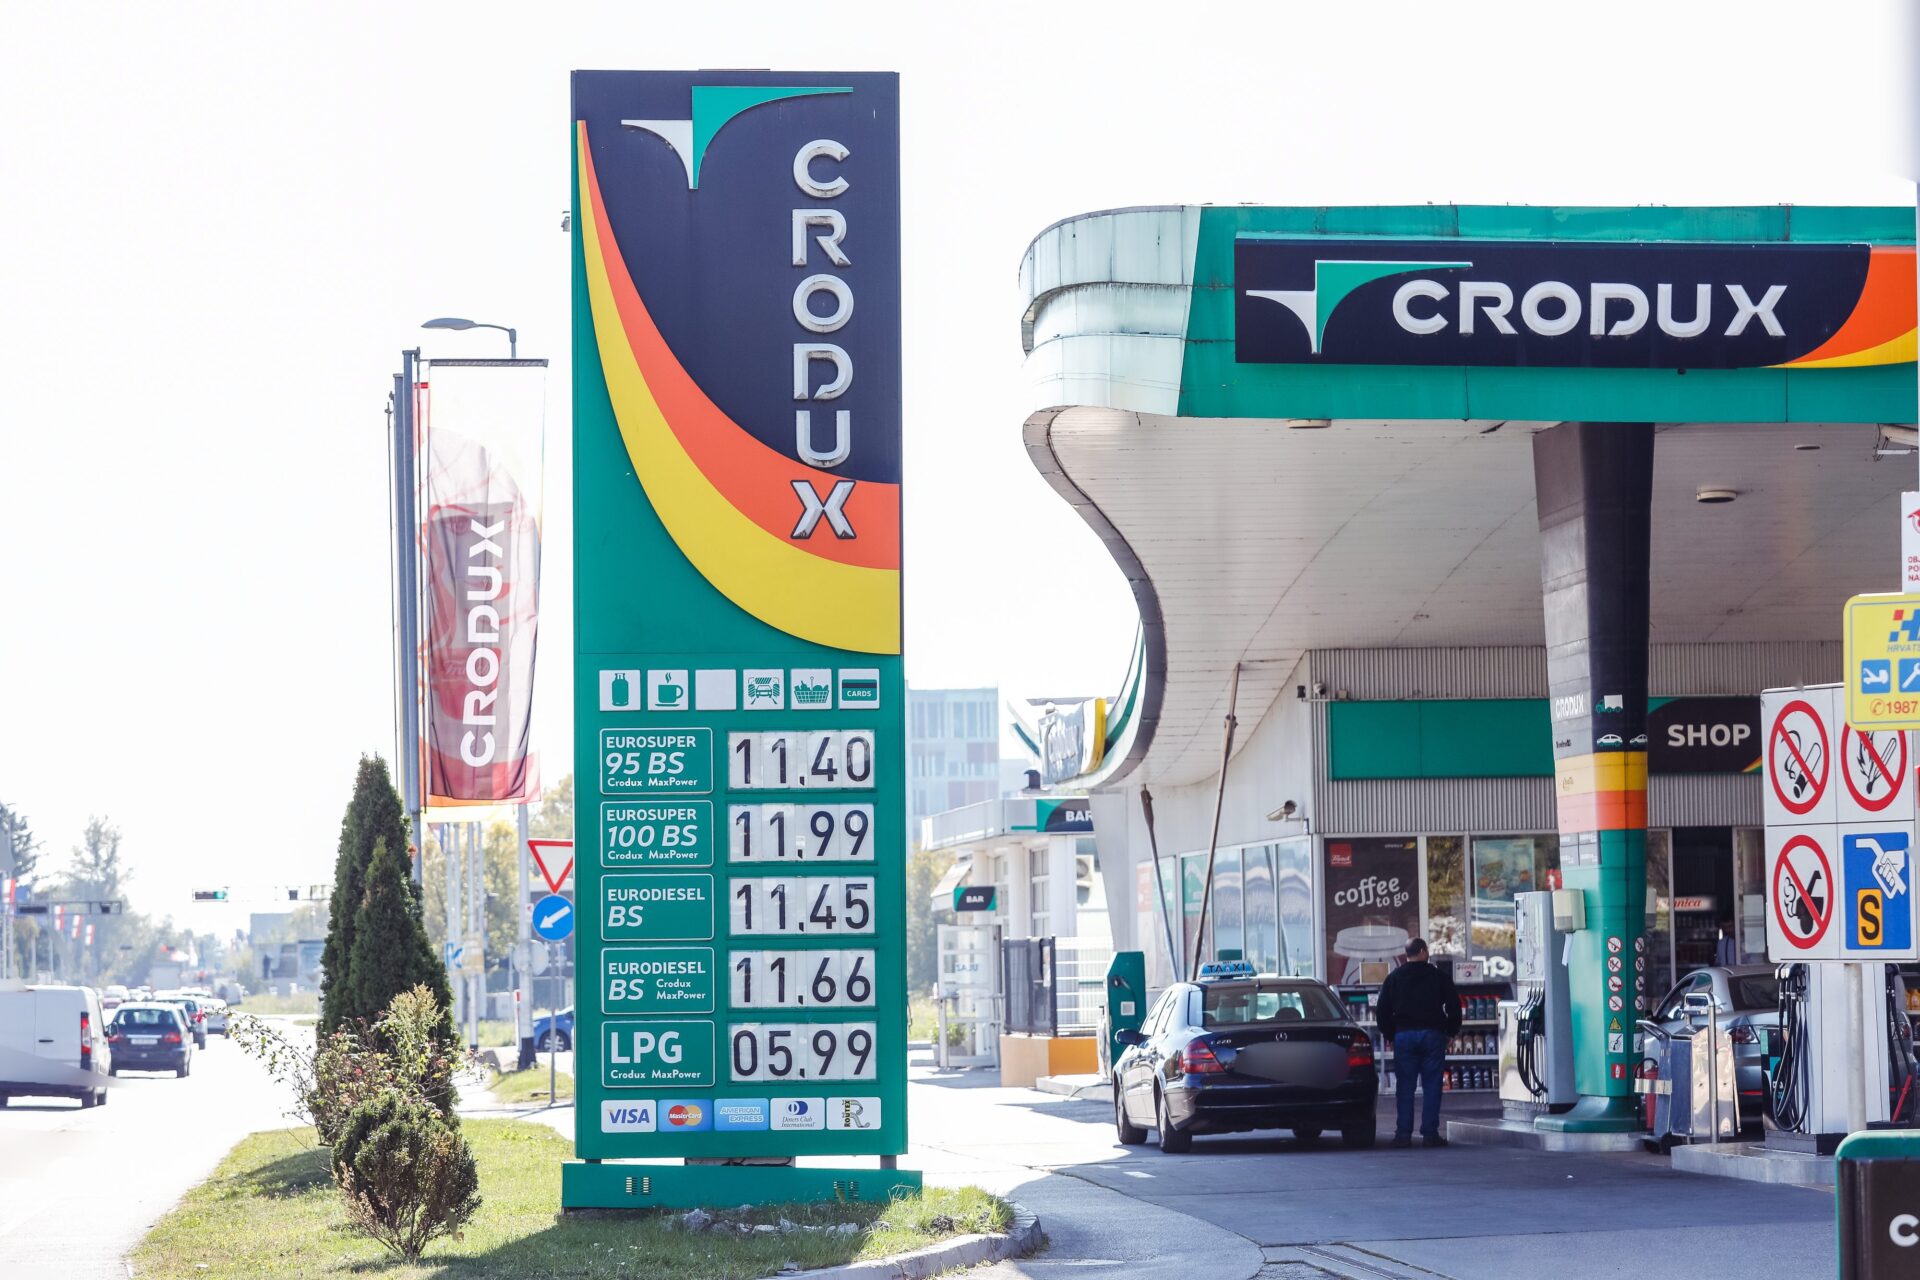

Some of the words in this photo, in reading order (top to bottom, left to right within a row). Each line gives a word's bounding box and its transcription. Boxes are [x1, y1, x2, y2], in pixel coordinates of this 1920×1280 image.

[1393, 279, 1787, 338] CRODUX
[790, 139, 857, 539] CRODUX
[460, 519, 505, 768] CRODUX
[1555, 694, 1584, 719] CRODUX
[1886, 701, 1918, 714] 1987
[606, 736, 697, 749] EUROSUPER
[1667, 724, 1751, 747] SHOP
[605, 752, 641, 775] 95
[648, 752, 685, 774] BS
[607, 777, 643, 787] Crodux
[648, 777, 698, 787] MaxPower
[606, 808, 697, 821] EUROSUPER
[607, 825, 655, 848] 100
[661, 825, 698, 847] BS
[607, 850, 643, 860] Crodux
[648, 850, 698, 860] MaxPower
[607, 888, 706, 901] EURODIESEL
[1334, 876, 1400, 907] coffee
[1375, 896, 1390, 908] to
[1393, 892, 1409, 907] go
[607, 905, 644, 927] BS
[1860, 894, 1880, 940] S
[608, 961, 706, 975] EURODIESEL
[1207, 963, 1245, 973] TAXI
[608, 979, 645, 1001] BS
[656, 979, 691, 989] Crodux
[656, 990, 706, 1000] MaxPower
[610, 1031, 683, 1064] LPG
[610, 1069, 646, 1080] Crodux
[651, 1069, 701, 1080] MaxPower
[608, 1108, 650, 1124] VISA
